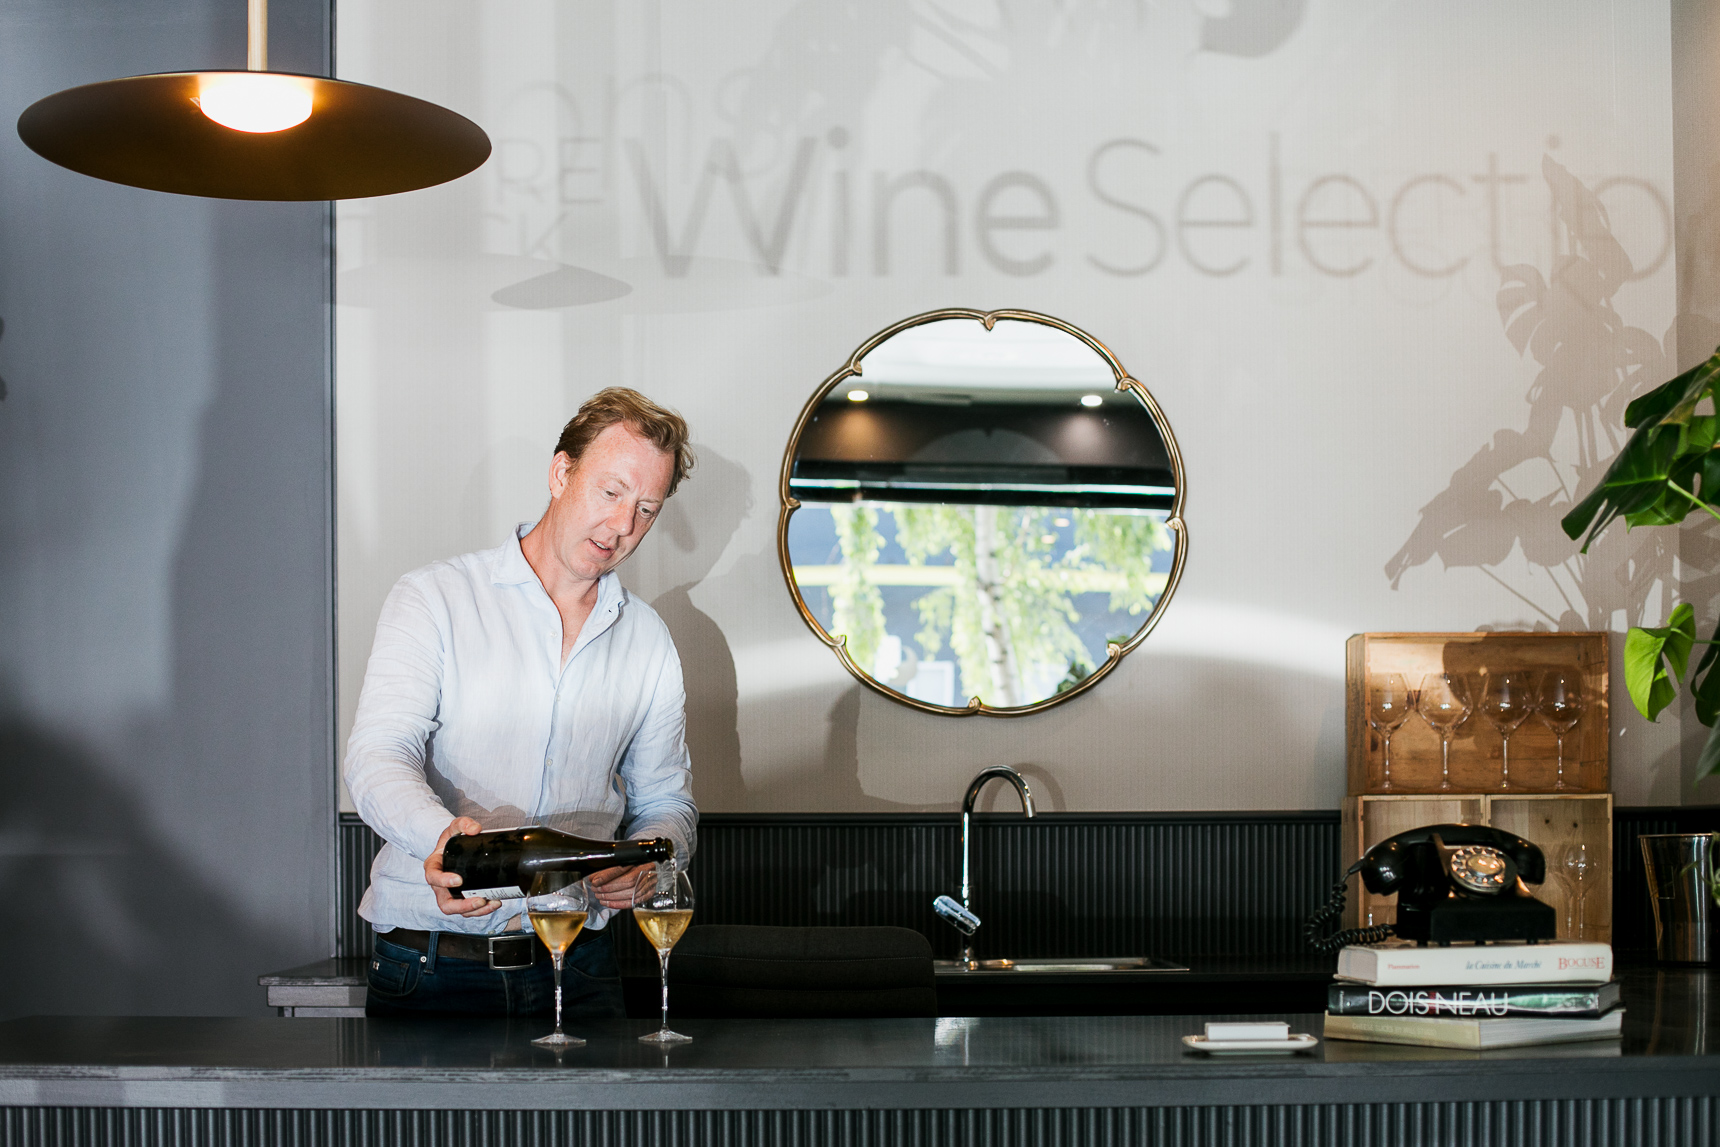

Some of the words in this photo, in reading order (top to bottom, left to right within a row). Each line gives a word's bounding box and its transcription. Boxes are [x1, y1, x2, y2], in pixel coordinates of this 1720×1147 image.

[622, 126, 1061, 280] Wine
[1474, 960, 1501, 970] Cuisine
[1558, 956, 1605, 970] BOCUSE
[1368, 991, 1509, 1016] DOISNEAU
